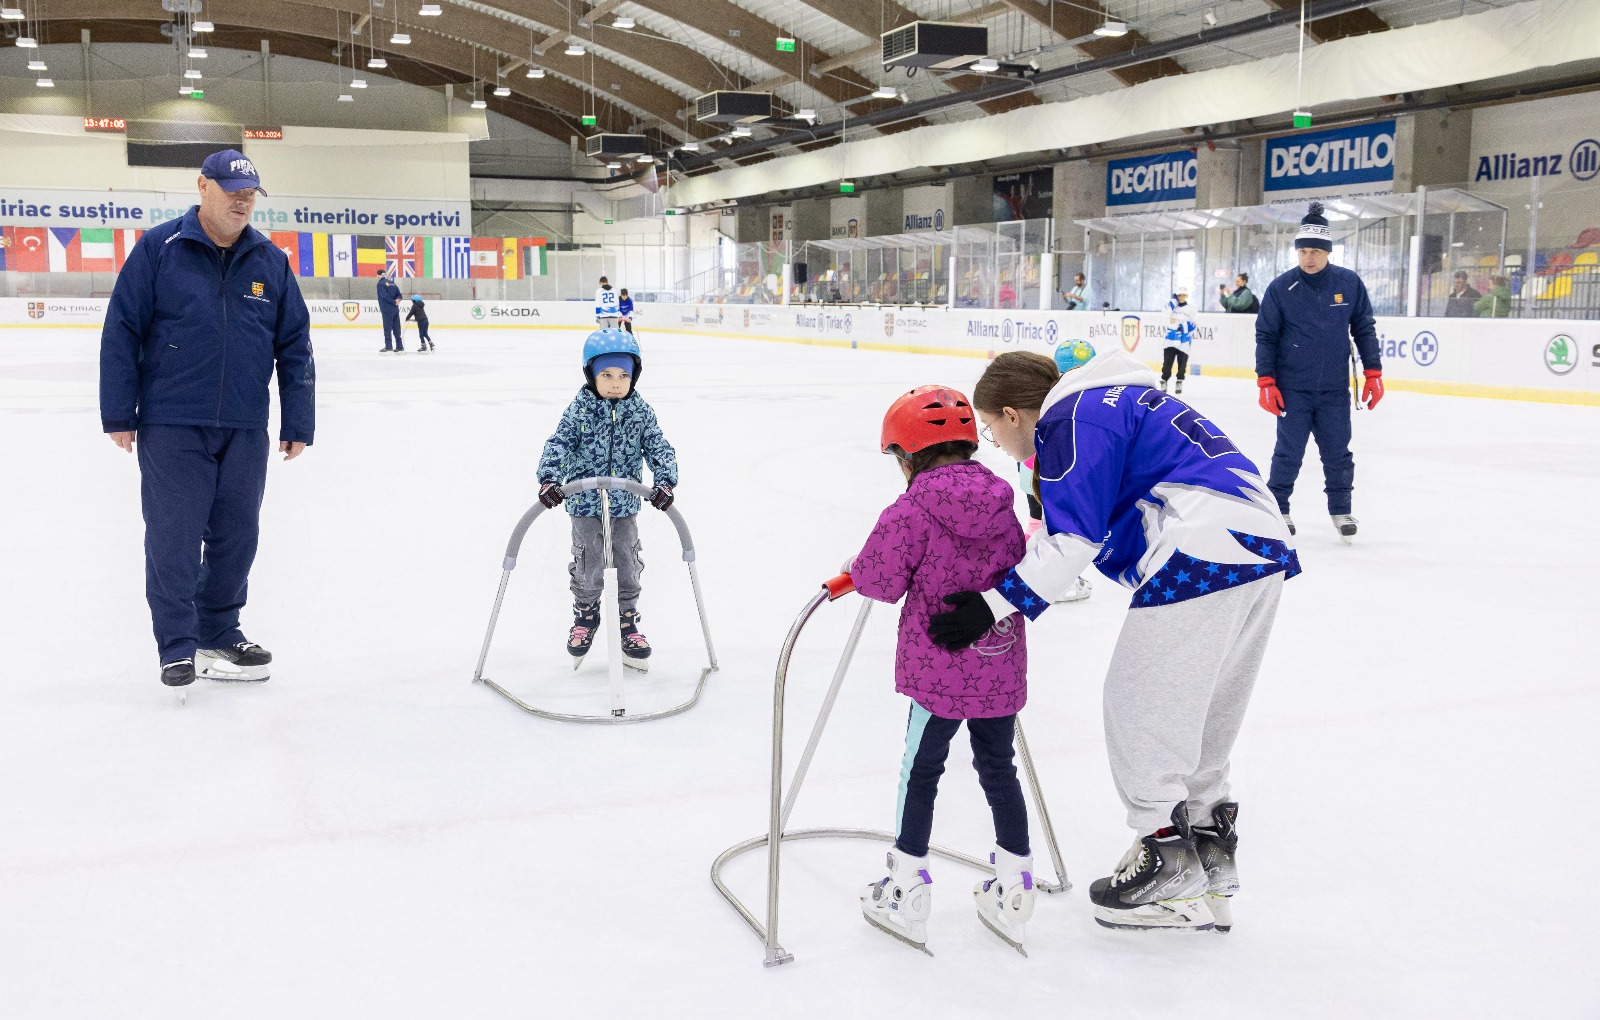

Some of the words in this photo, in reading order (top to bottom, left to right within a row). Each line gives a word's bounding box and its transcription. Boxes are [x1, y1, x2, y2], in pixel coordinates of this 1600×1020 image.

[84, 118, 125, 129] 13:47:05
[244, 130, 281, 138] 26.10.2024
[1475, 152, 1563, 182] Allianz
[58, 201, 144, 225] susține
[294, 206, 379, 225] tinerilor
[384, 210, 460, 230] sportivi
[904, 214, 933, 231] Allianz
[602, 292, 615, 304] 22
[796, 314, 817, 328] Allianz
[967, 320, 999, 338] Allianz
[1015, 321, 1043, 344] Țiriac
[1089, 323, 1118, 338] BANCA
[1125, 324, 1137, 337] BT
